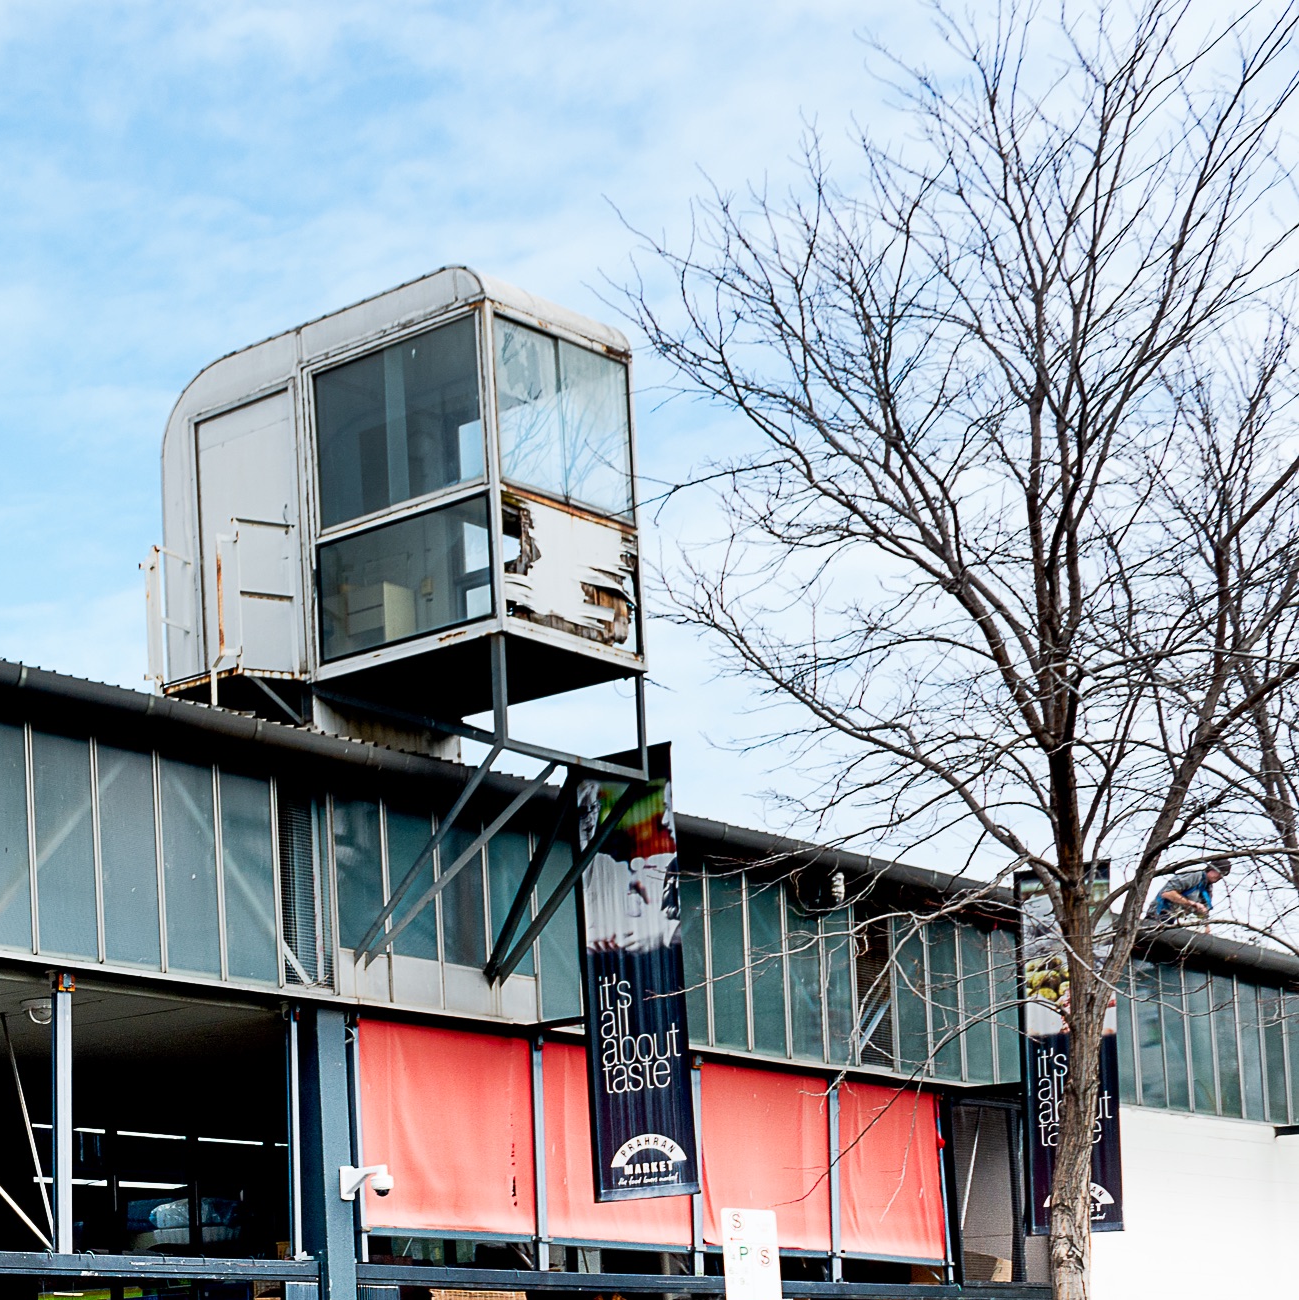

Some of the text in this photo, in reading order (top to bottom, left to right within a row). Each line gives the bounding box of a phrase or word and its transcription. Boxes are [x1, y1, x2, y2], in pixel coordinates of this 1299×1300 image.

[598, 973, 632, 1011] it's
[600, 999, 630, 1039] all
[602, 1022, 682, 1067] about
[1037, 1047, 1068, 1078] it's
[602, 1054, 671, 1094] taste
[620, 1136, 676, 1158] PRAHRAN
[623, 1160, 674, 1175] MARKET
